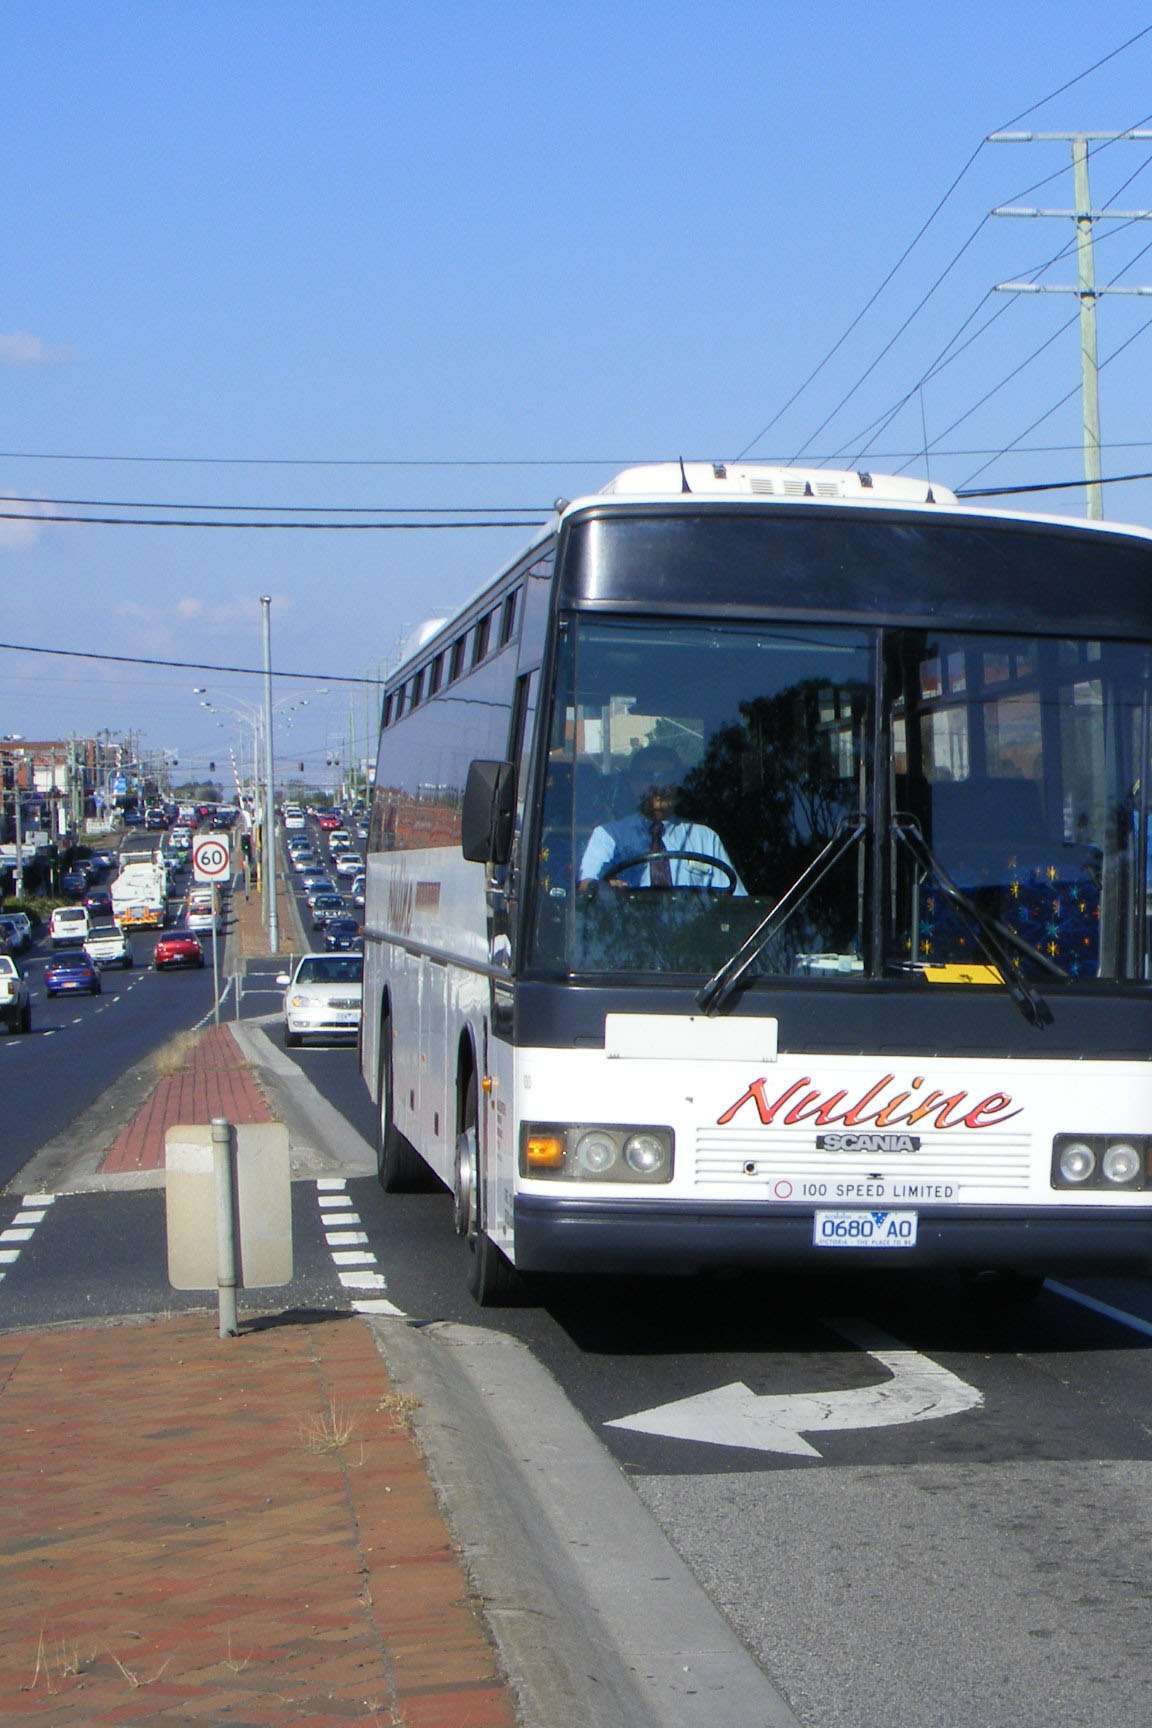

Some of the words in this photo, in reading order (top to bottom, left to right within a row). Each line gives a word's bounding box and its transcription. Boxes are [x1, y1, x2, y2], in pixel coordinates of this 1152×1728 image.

[201, 850, 223, 866] 60
[716, 1073, 1025, 1129] Nuline
[824, 1134, 914, 1152] SCANIA
[802, 1184, 827, 1197] 100
[836, 1185, 885, 1198] SPEED
[893, 1186, 953, 1199] LIMITED
[822, 1220, 874, 1238] 0680
